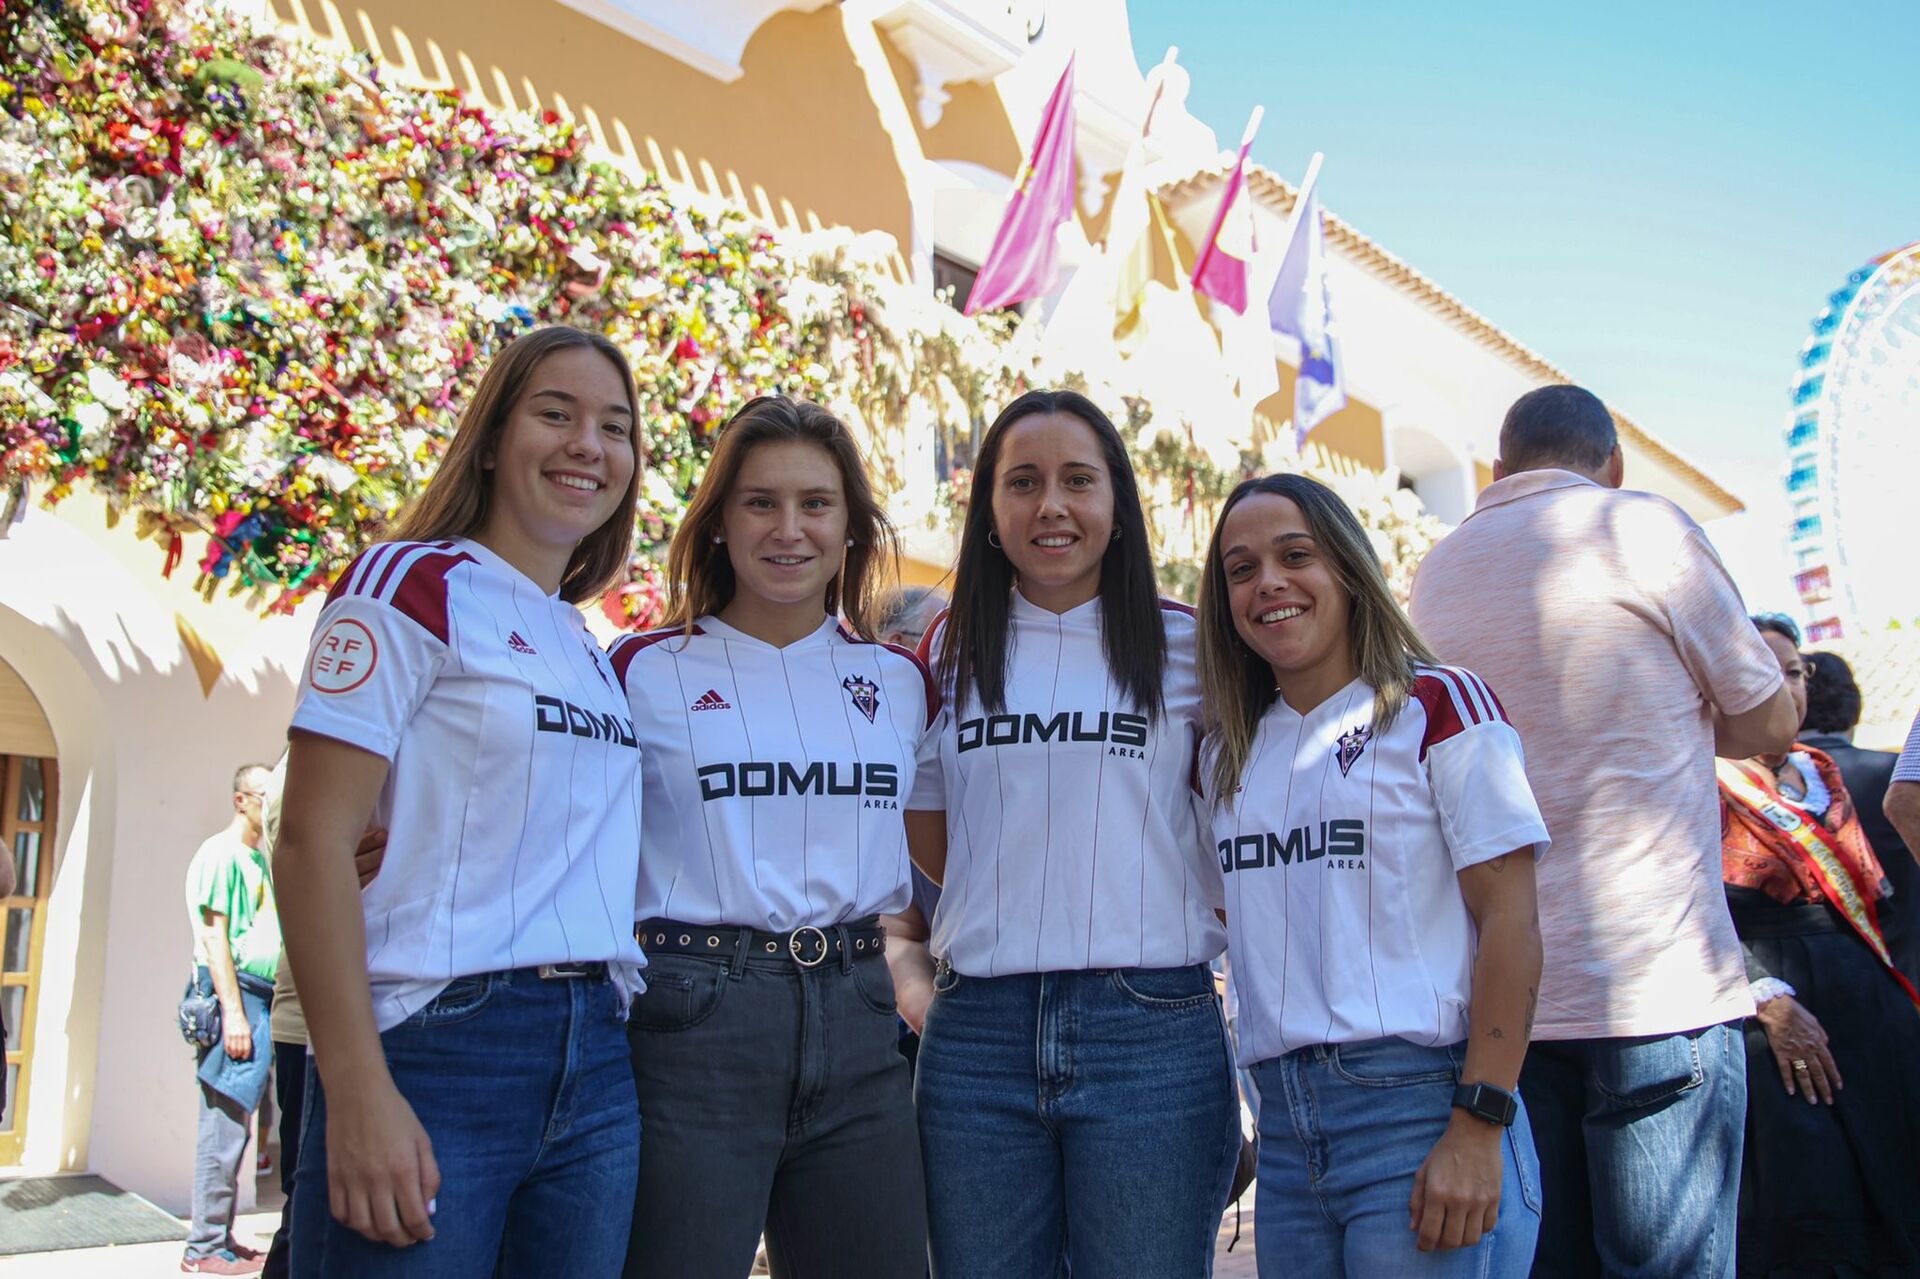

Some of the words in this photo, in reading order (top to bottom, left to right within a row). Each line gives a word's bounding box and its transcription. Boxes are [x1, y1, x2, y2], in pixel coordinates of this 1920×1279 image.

[690, 702, 732, 712] adidas
[535, 694, 639, 749] DOMU
[957, 711, 1148, 754] DOMUS
[1108, 746, 1146, 761] AREA
[697, 761, 898, 802] DOMUS
[863, 799, 898, 810] AREA
[1217, 819, 1365, 874] DOMUS
[1327, 859, 1366, 870] AREA
